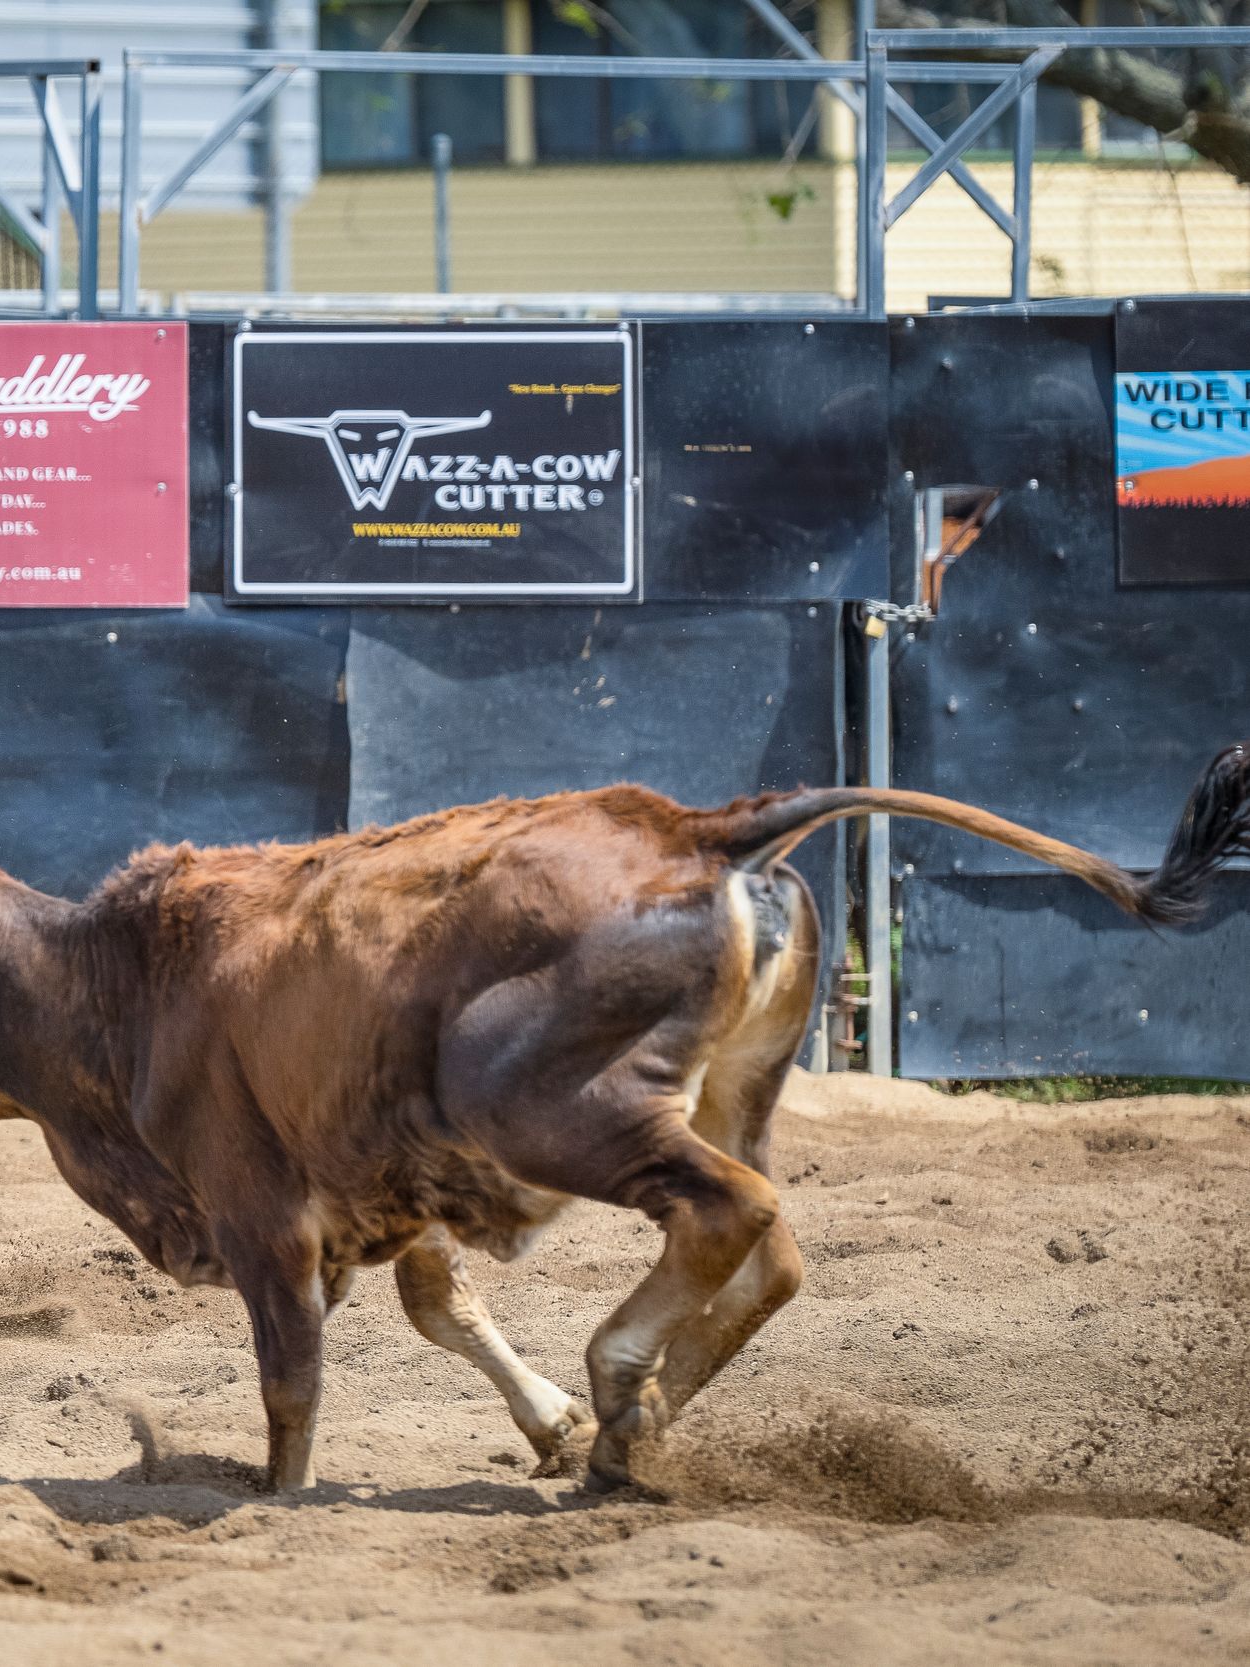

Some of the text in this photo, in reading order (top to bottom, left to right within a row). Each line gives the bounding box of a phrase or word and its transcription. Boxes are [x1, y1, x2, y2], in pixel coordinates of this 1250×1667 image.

[1124, 380, 1229, 402] WIDE
[32, 467, 92, 482] GEAR...
[349, 447, 621, 482] WAZZ-A-COW
